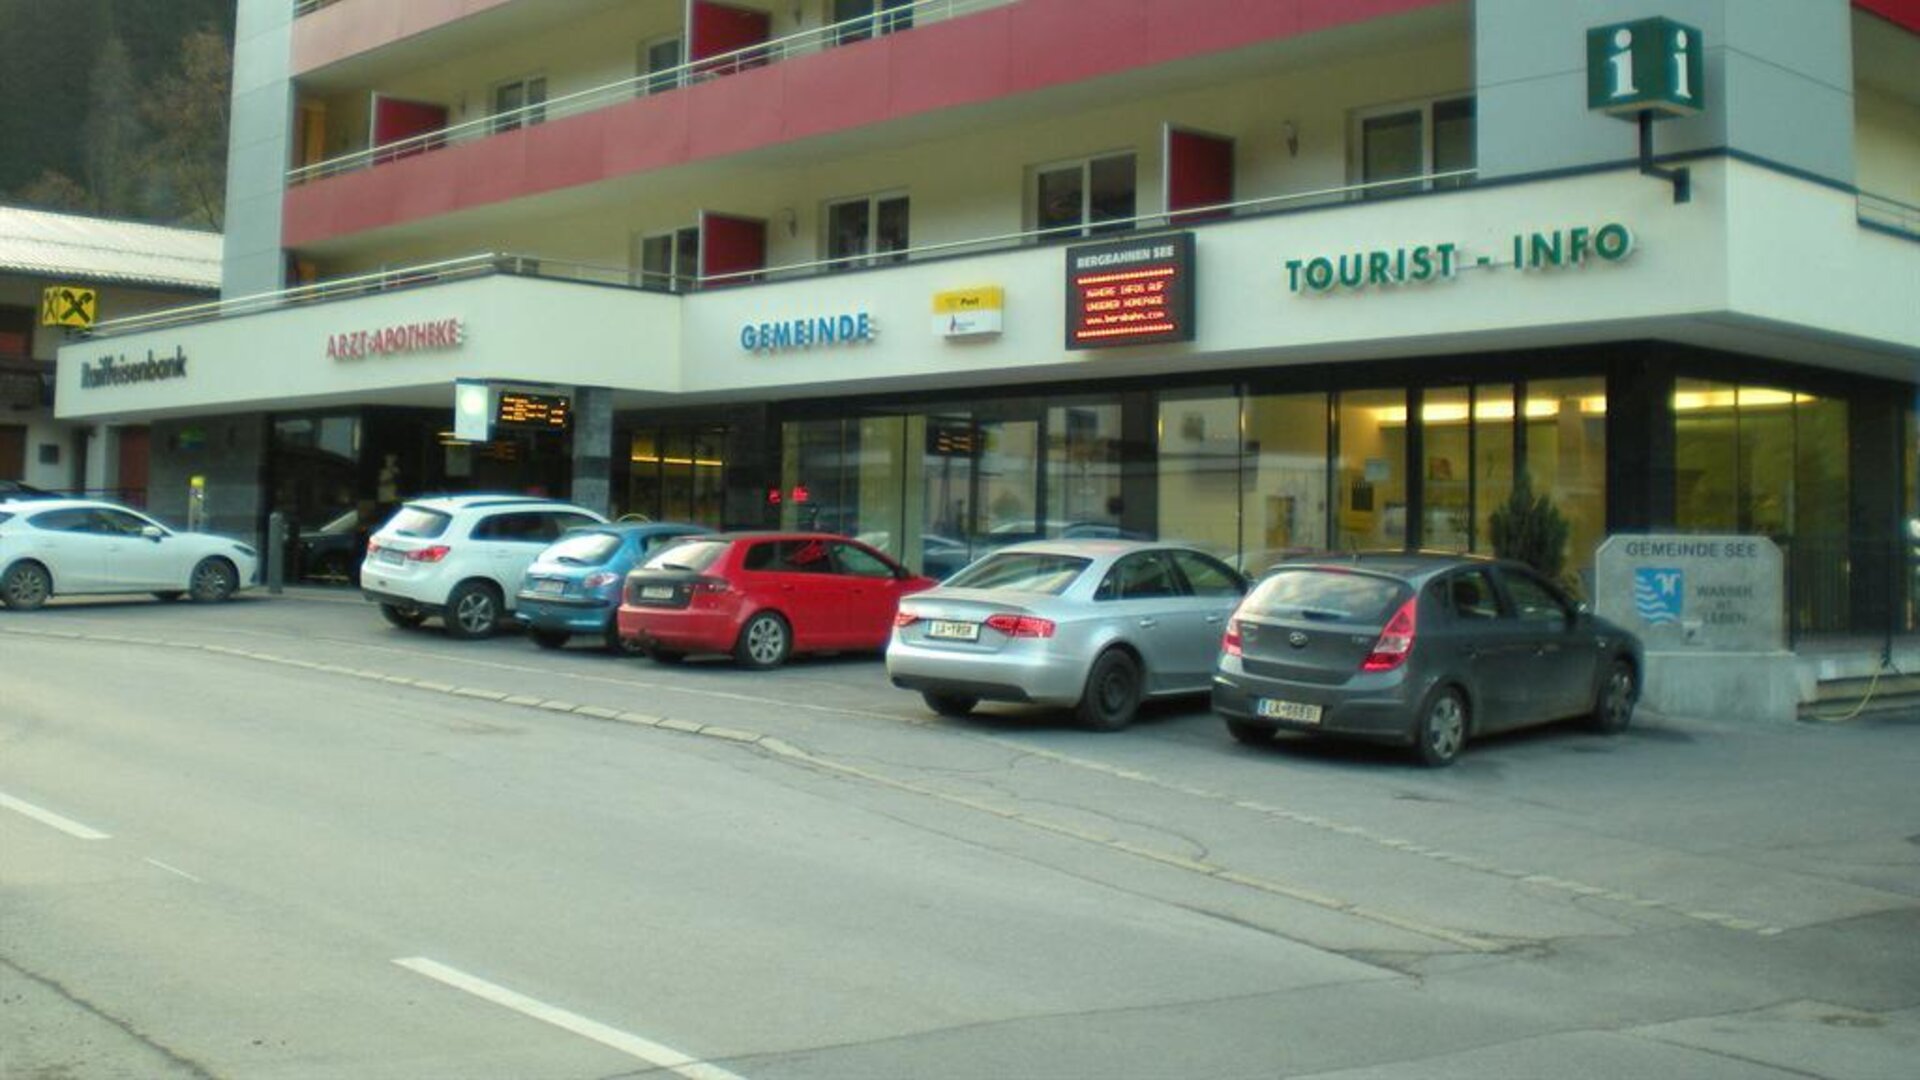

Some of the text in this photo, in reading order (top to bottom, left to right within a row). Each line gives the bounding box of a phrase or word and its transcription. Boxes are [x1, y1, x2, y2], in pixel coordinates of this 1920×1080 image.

[1077, 245, 1175, 269] BERGBAHNEN SEE
[1285, 243, 1456, 292] TOURIST
[1513, 222, 1631, 270] INFO
[740, 312, 870, 350] GEMEINDE
[81, 345, 188, 389] Raiffeisenbank
[1625, 541, 1759, 558] GEMEINDE SEE
